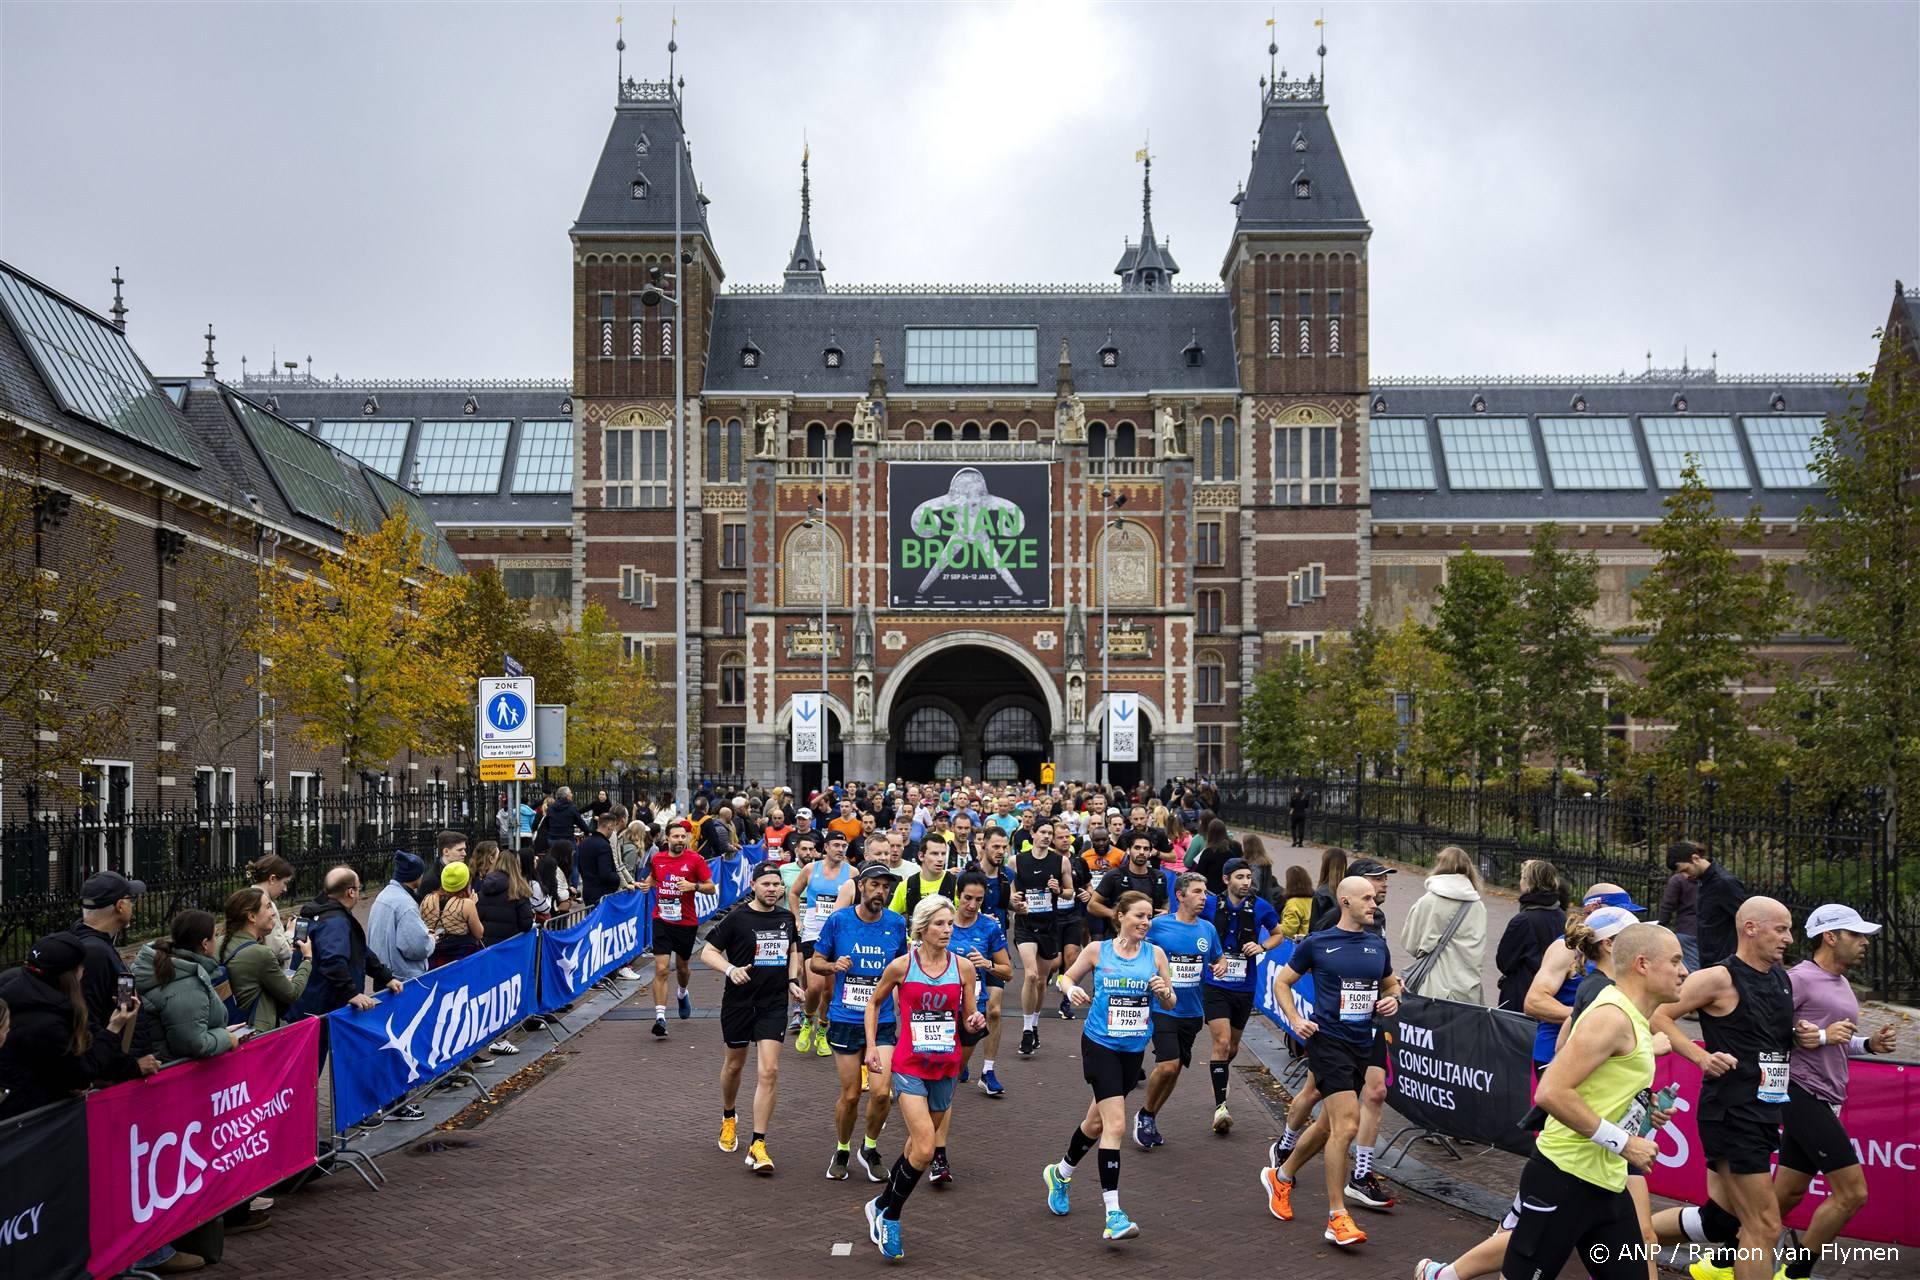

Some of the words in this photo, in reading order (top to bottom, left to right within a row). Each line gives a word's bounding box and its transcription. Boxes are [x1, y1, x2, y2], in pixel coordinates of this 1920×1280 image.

[917, 506, 1021, 536] ASIAN
[902, 539, 1038, 569] BRONZE
[495, 682, 519, 690] ZONE
[851, 942, 885, 956] Ama,
[860, 958, 886, 969] txo!
[1342, 981, 1355, 989] tcs
[1110, 997, 1122, 1006] tcs
[1349, 994, 1372, 1002] FLORIS
[912, 1012, 924, 1021] tcs
[1116, 1010, 1142, 1018] FRIEDA
[924, 1025, 941, 1033] ELLY
[1399, 1022, 1434, 1050] TATA
[1399, 1048, 1494, 1093] CONSULTANCY
[210, 1080, 251, 1117] TATA
[1399, 1074, 1456, 1111] SERVICES
[130, 1120, 208, 1223] tcs
